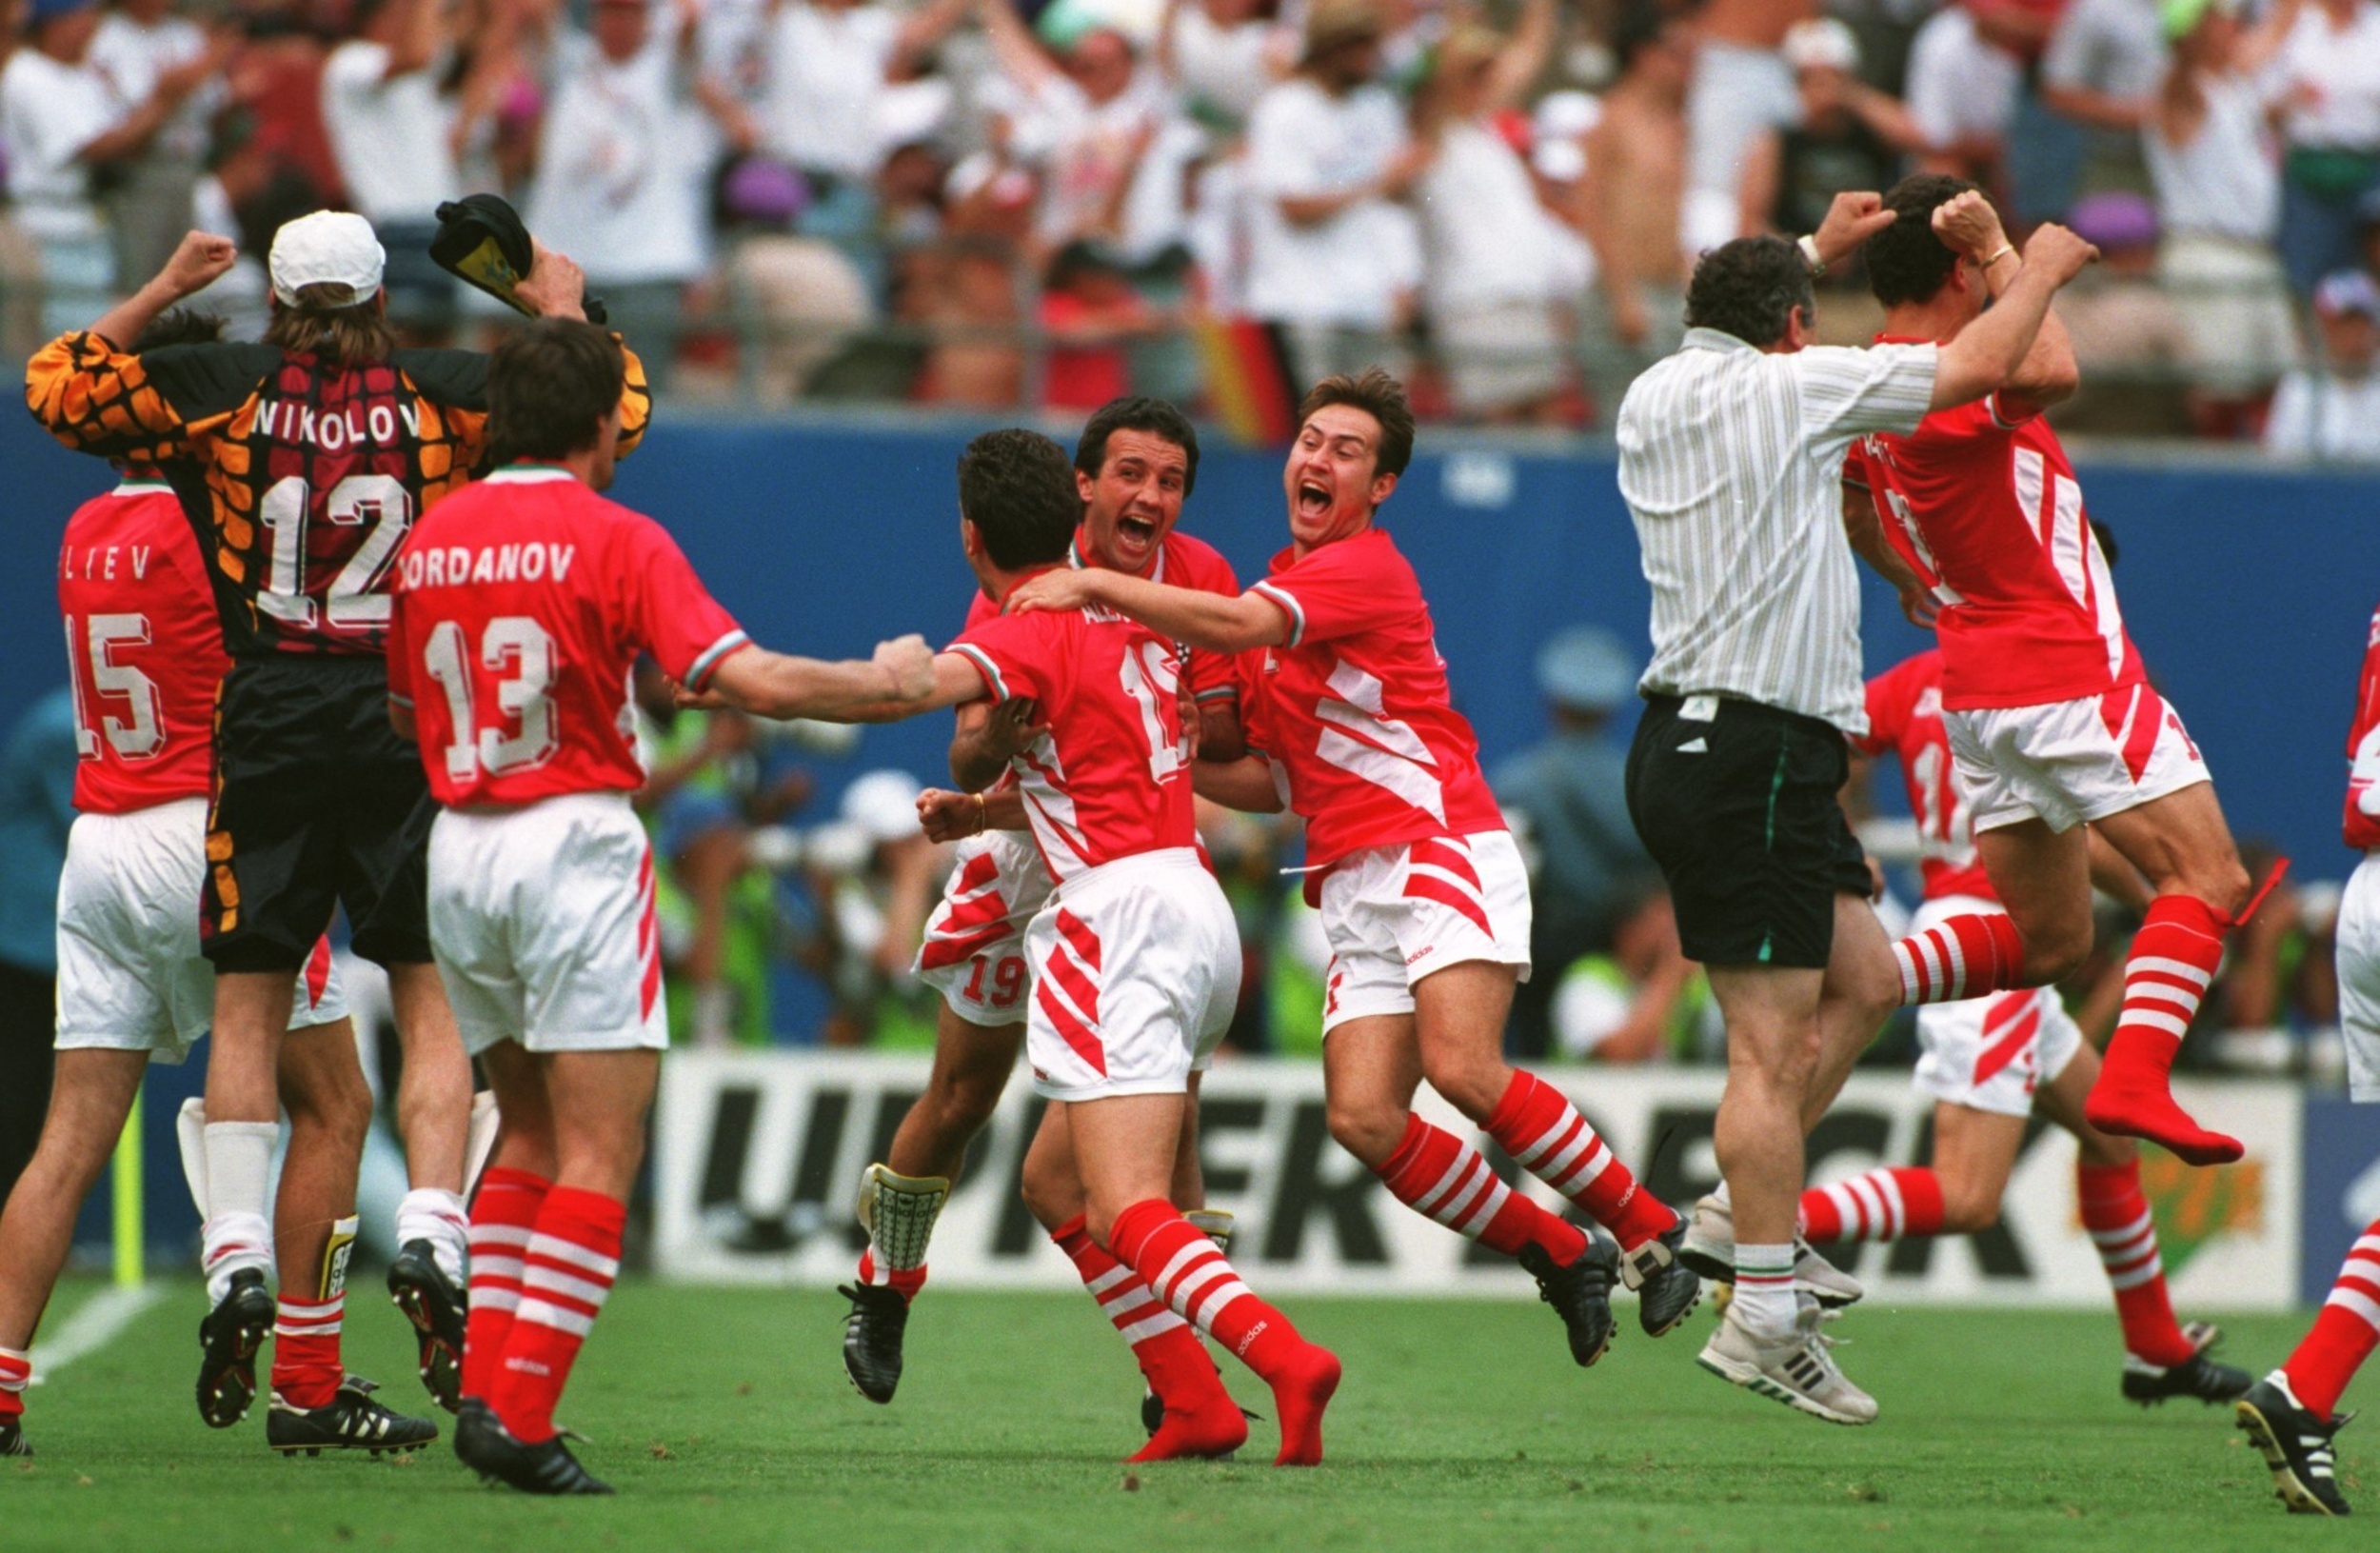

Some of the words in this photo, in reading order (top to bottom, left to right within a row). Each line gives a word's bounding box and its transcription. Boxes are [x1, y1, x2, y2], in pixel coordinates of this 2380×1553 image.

[251, 398, 420, 449] NIKOLOV
[256, 475, 412, 629] 12
[64, 612, 167, 762] 15
[424, 615, 559, 784] 13
[962, 953, 1028, 1009] 19
[1238, 1321, 1268, 1356] adidas
